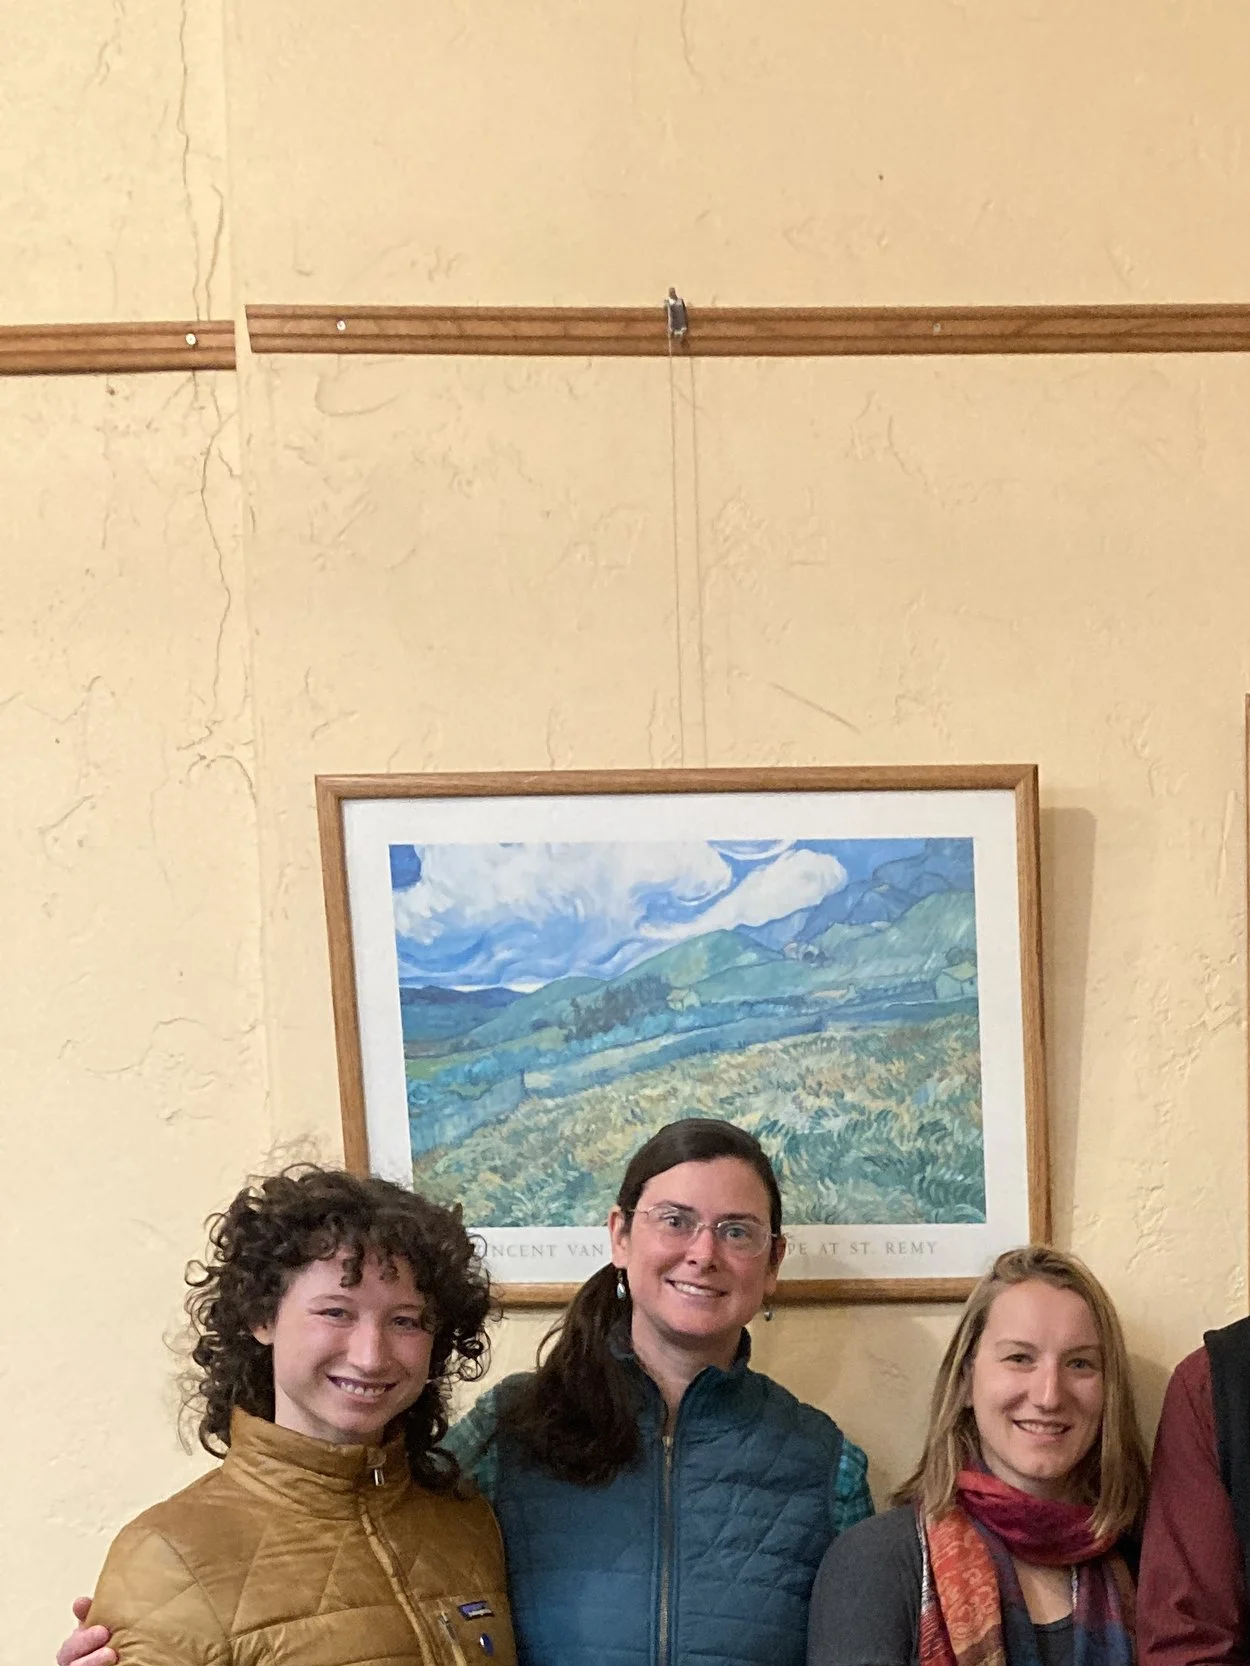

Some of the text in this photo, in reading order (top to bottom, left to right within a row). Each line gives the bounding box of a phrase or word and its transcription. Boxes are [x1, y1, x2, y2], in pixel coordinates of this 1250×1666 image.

[485, 1243, 604, 1258] NCENT VAN
[820, 1241, 840, 1255] AT
[885, 1240, 938, 1255] REMY
